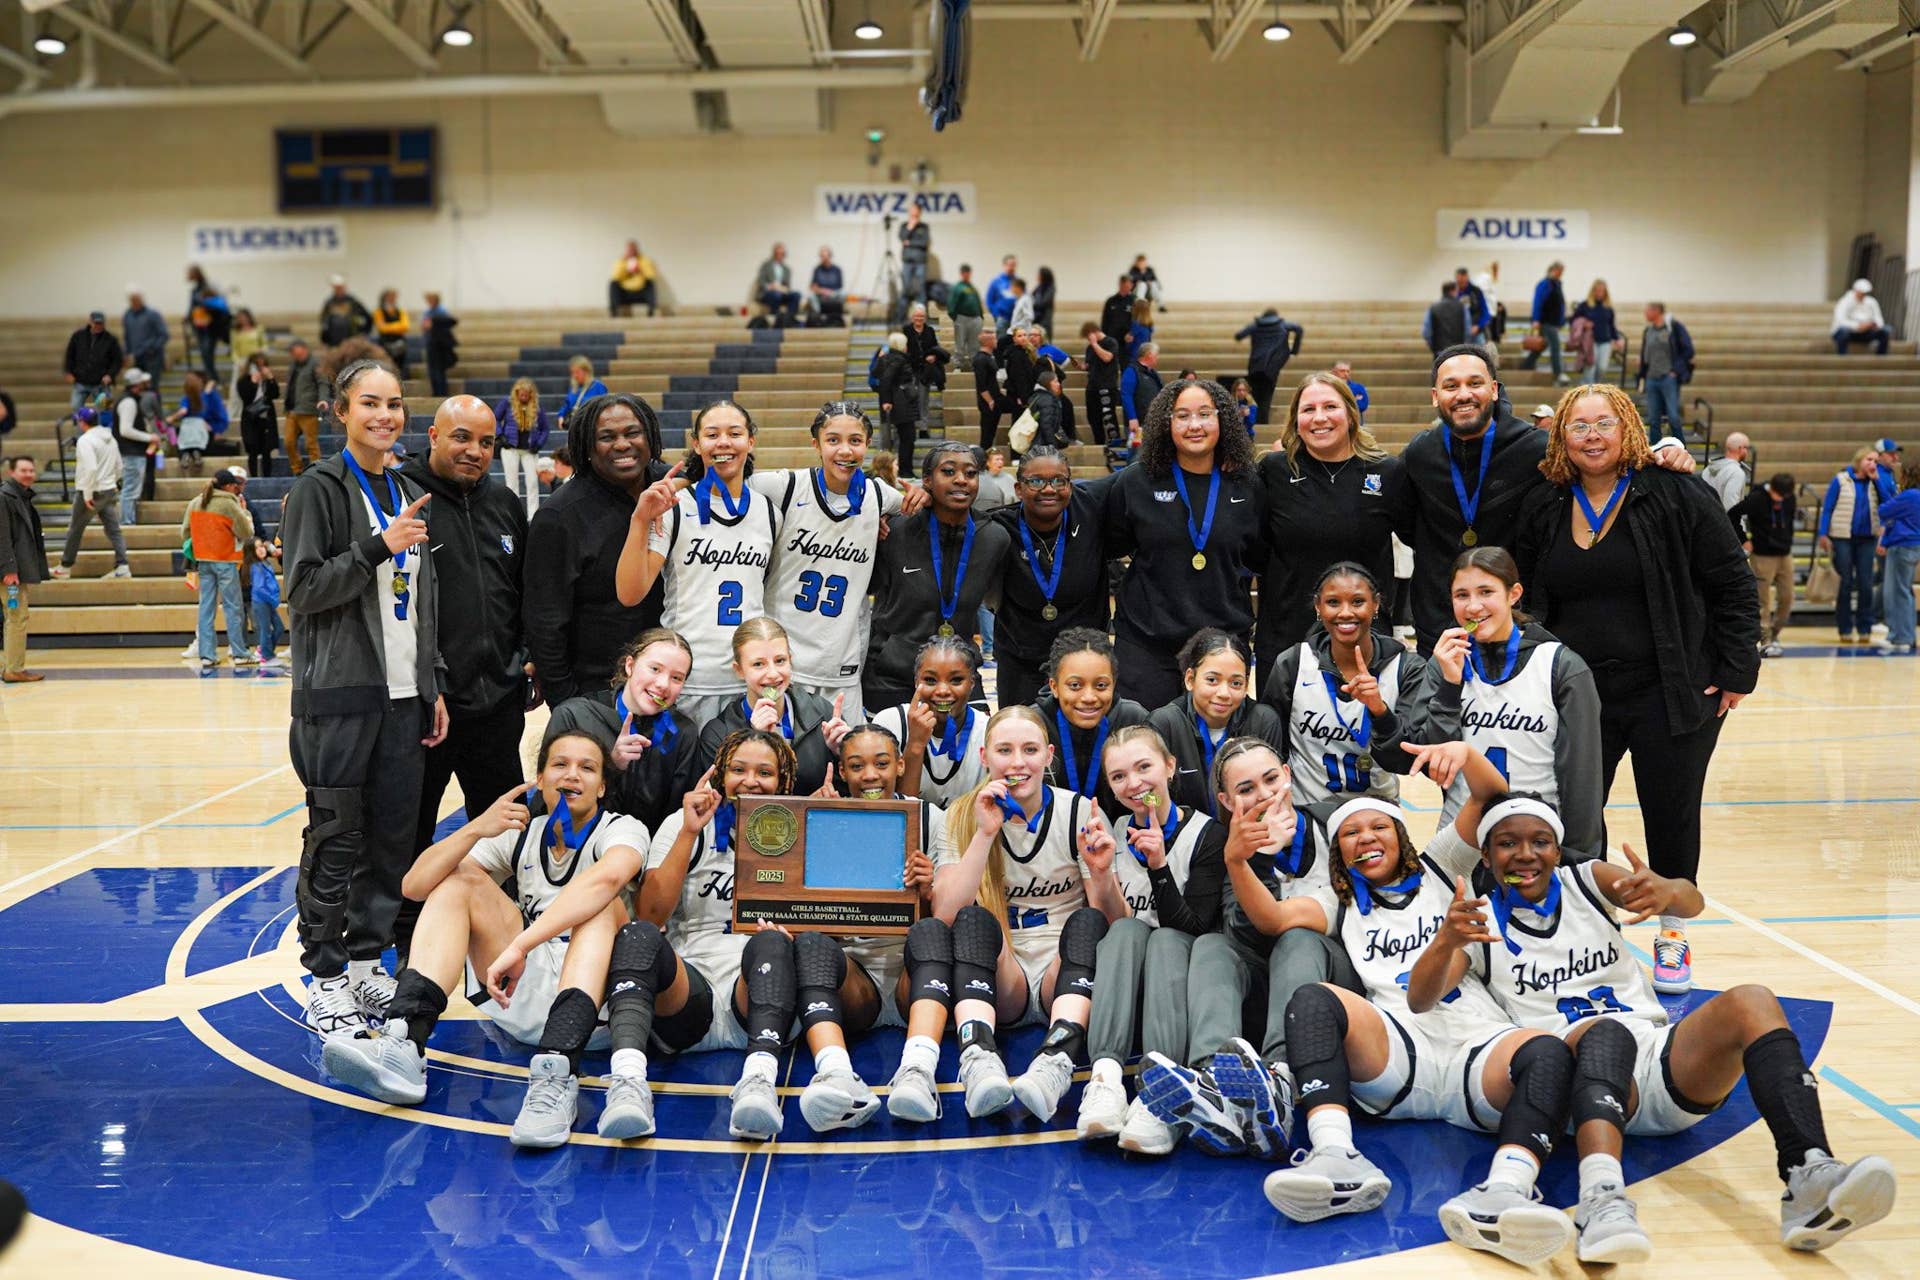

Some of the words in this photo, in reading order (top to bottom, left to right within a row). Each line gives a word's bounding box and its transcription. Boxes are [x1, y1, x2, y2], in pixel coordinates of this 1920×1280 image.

[826, 192, 965, 213] WAYZATA
[195, 226, 338, 250] STUDENTS
[1460, 218, 1567, 239] ADULTS
[684, 538, 767, 571] Hopkins
[787, 528, 869, 564] Hopkins
[717, 580, 743, 626] 2
[794, 570, 848, 618] 33
[1322, 753, 1371, 792] 10
[759, 871, 782, 881] 2025
[1004, 876, 1075, 901] pkins
[791, 904, 814, 912] GIRLS
[815, 905, 861, 913] BASKETBALL
[799, 912, 838, 920] CHAMPION
[1511, 941, 1619, 995] Hopkins
